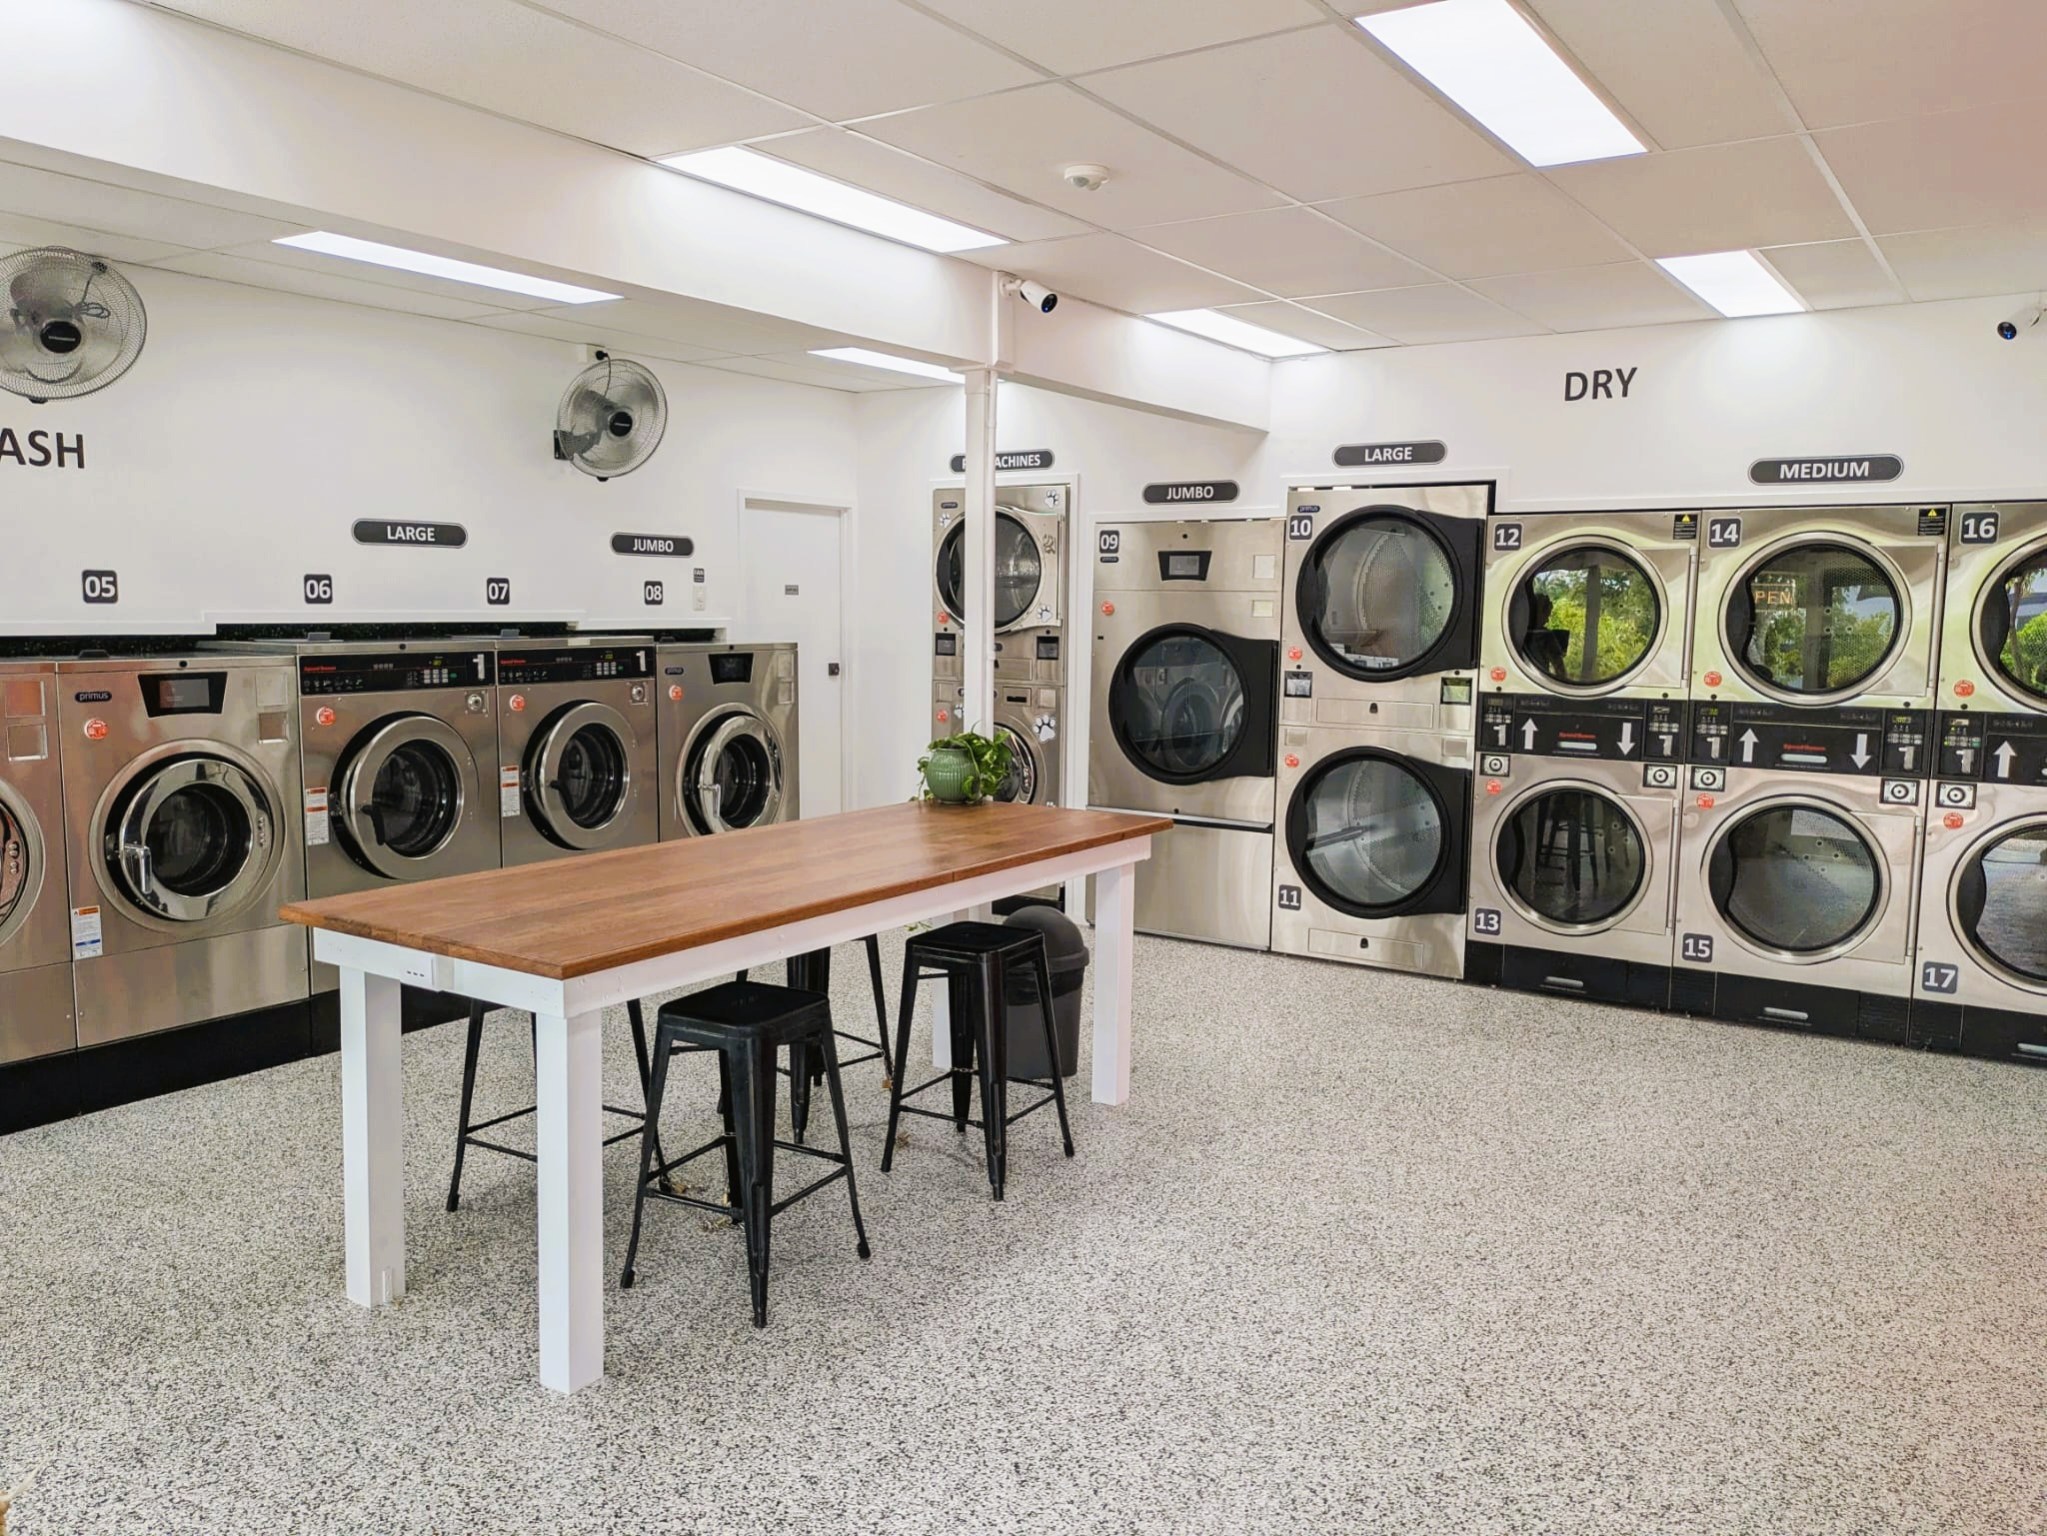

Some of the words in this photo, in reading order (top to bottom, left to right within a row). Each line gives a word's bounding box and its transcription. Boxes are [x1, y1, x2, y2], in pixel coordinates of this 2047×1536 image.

[1565, 367, 1638, 402] DRY
[995, 454, 1041, 468] ACHINES
[1364, 447, 1413, 462] LARGE
[1779, 461, 1870, 479] MEDIUM
[1166, 486, 1214, 500] JUMBO
[386, 525, 436, 542] LARGE
[1290, 519, 1312, 536] 10
[1711, 523, 1739, 543] 14
[1963, 518, 1996, 539] 16
[632, 538, 674, 553] JUMBO
[1100, 534, 1118, 550] 09
[1496, 528, 1520, 546] 12
[84, 576, 116, 598] 05
[305, 580, 331, 599] 06
[488, 583, 509, 601] 07
[645, 585, 662, 601] 08
[1280, 889, 1300, 907] 11
[1475, 912, 1499, 931] 13
[1684, 937, 1711, 958] 15
[1924, 968, 1955, 989] 17
